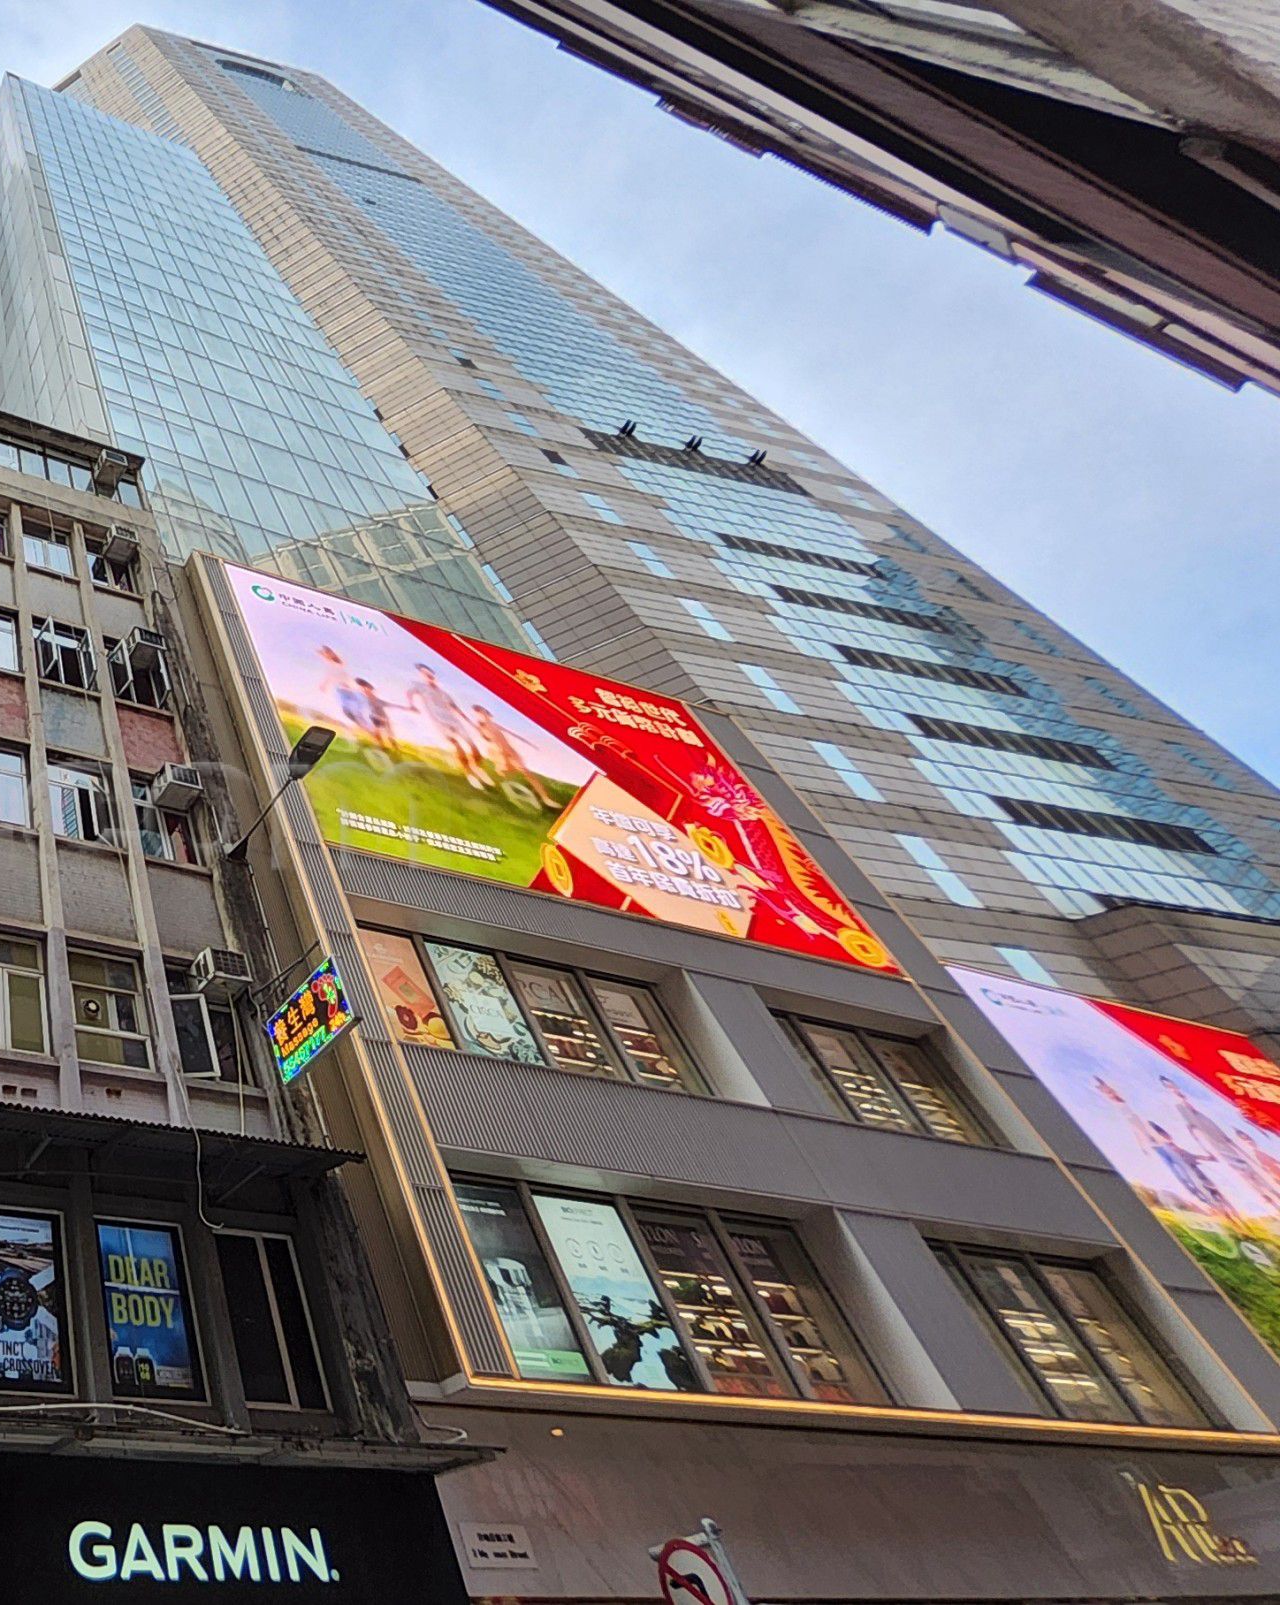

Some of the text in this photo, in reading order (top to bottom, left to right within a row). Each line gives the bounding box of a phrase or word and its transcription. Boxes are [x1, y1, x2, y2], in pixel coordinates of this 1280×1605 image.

[108, 1253, 171, 1289] DEAR
[111, 1292, 175, 1329] BODY
[2, 1356, 61, 1378] CROSSOVER
